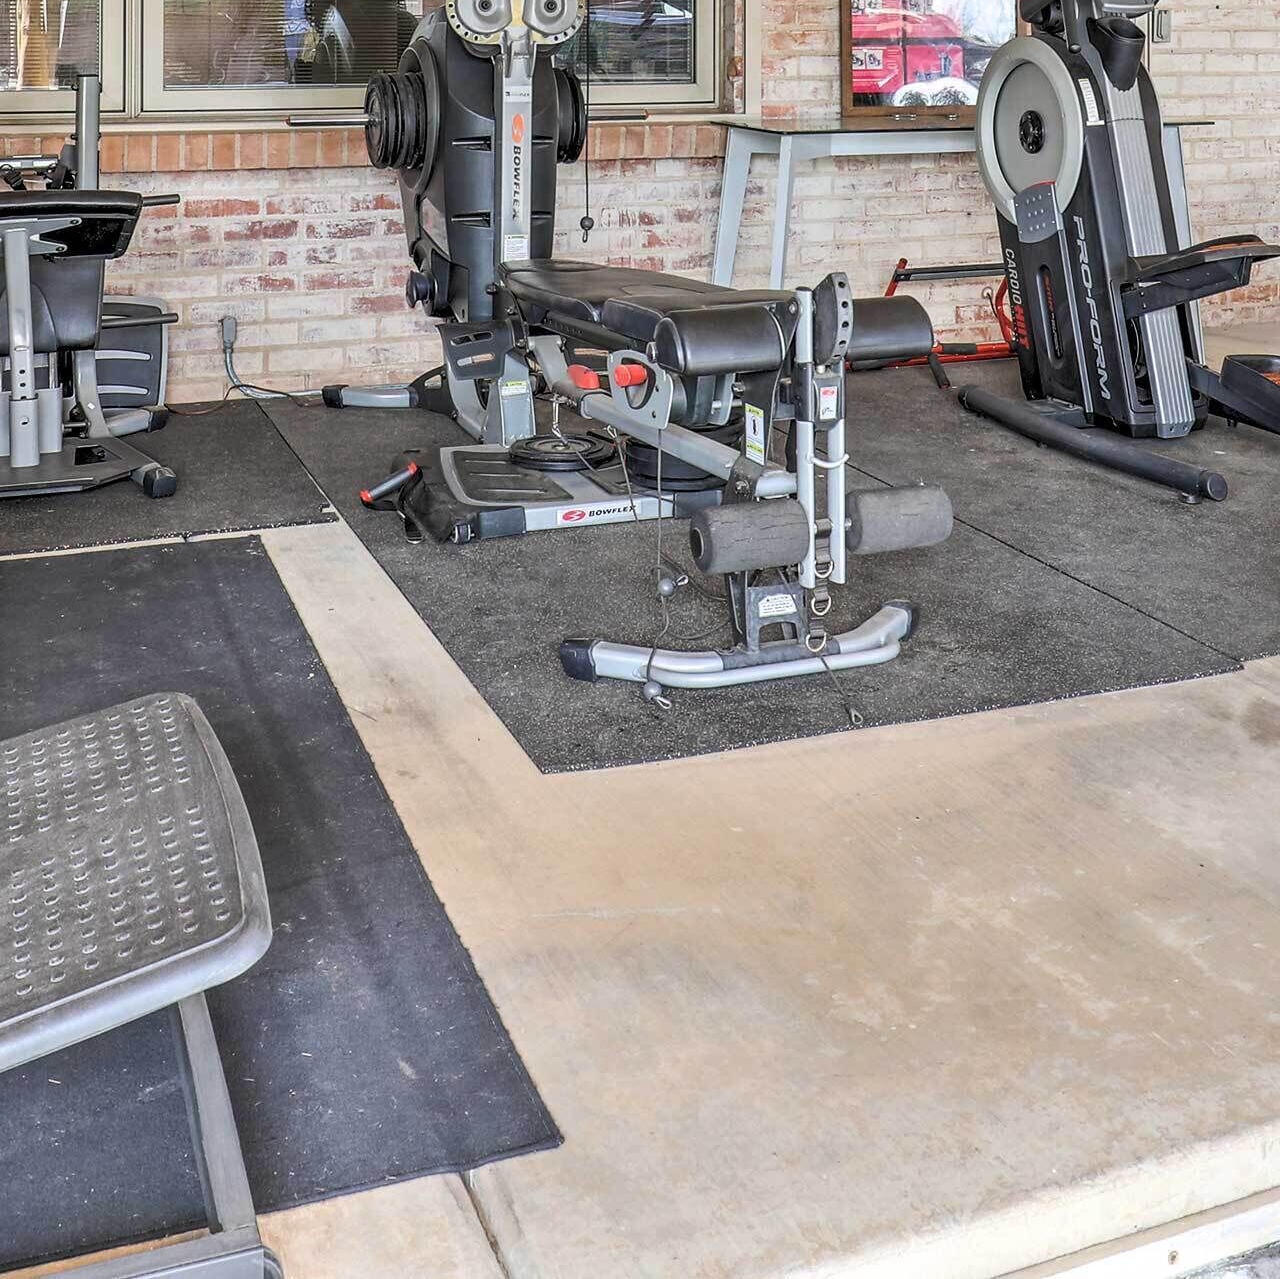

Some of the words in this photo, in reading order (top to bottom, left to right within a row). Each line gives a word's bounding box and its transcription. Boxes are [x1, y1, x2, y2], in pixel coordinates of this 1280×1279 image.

[511, 145, 522, 221] BOWFLEX
[1005, 248, 1023, 305] CARDIO
[1072, 215, 1112, 401] PRO-FORM
[588, 505, 636, 518] BOWFLEX
